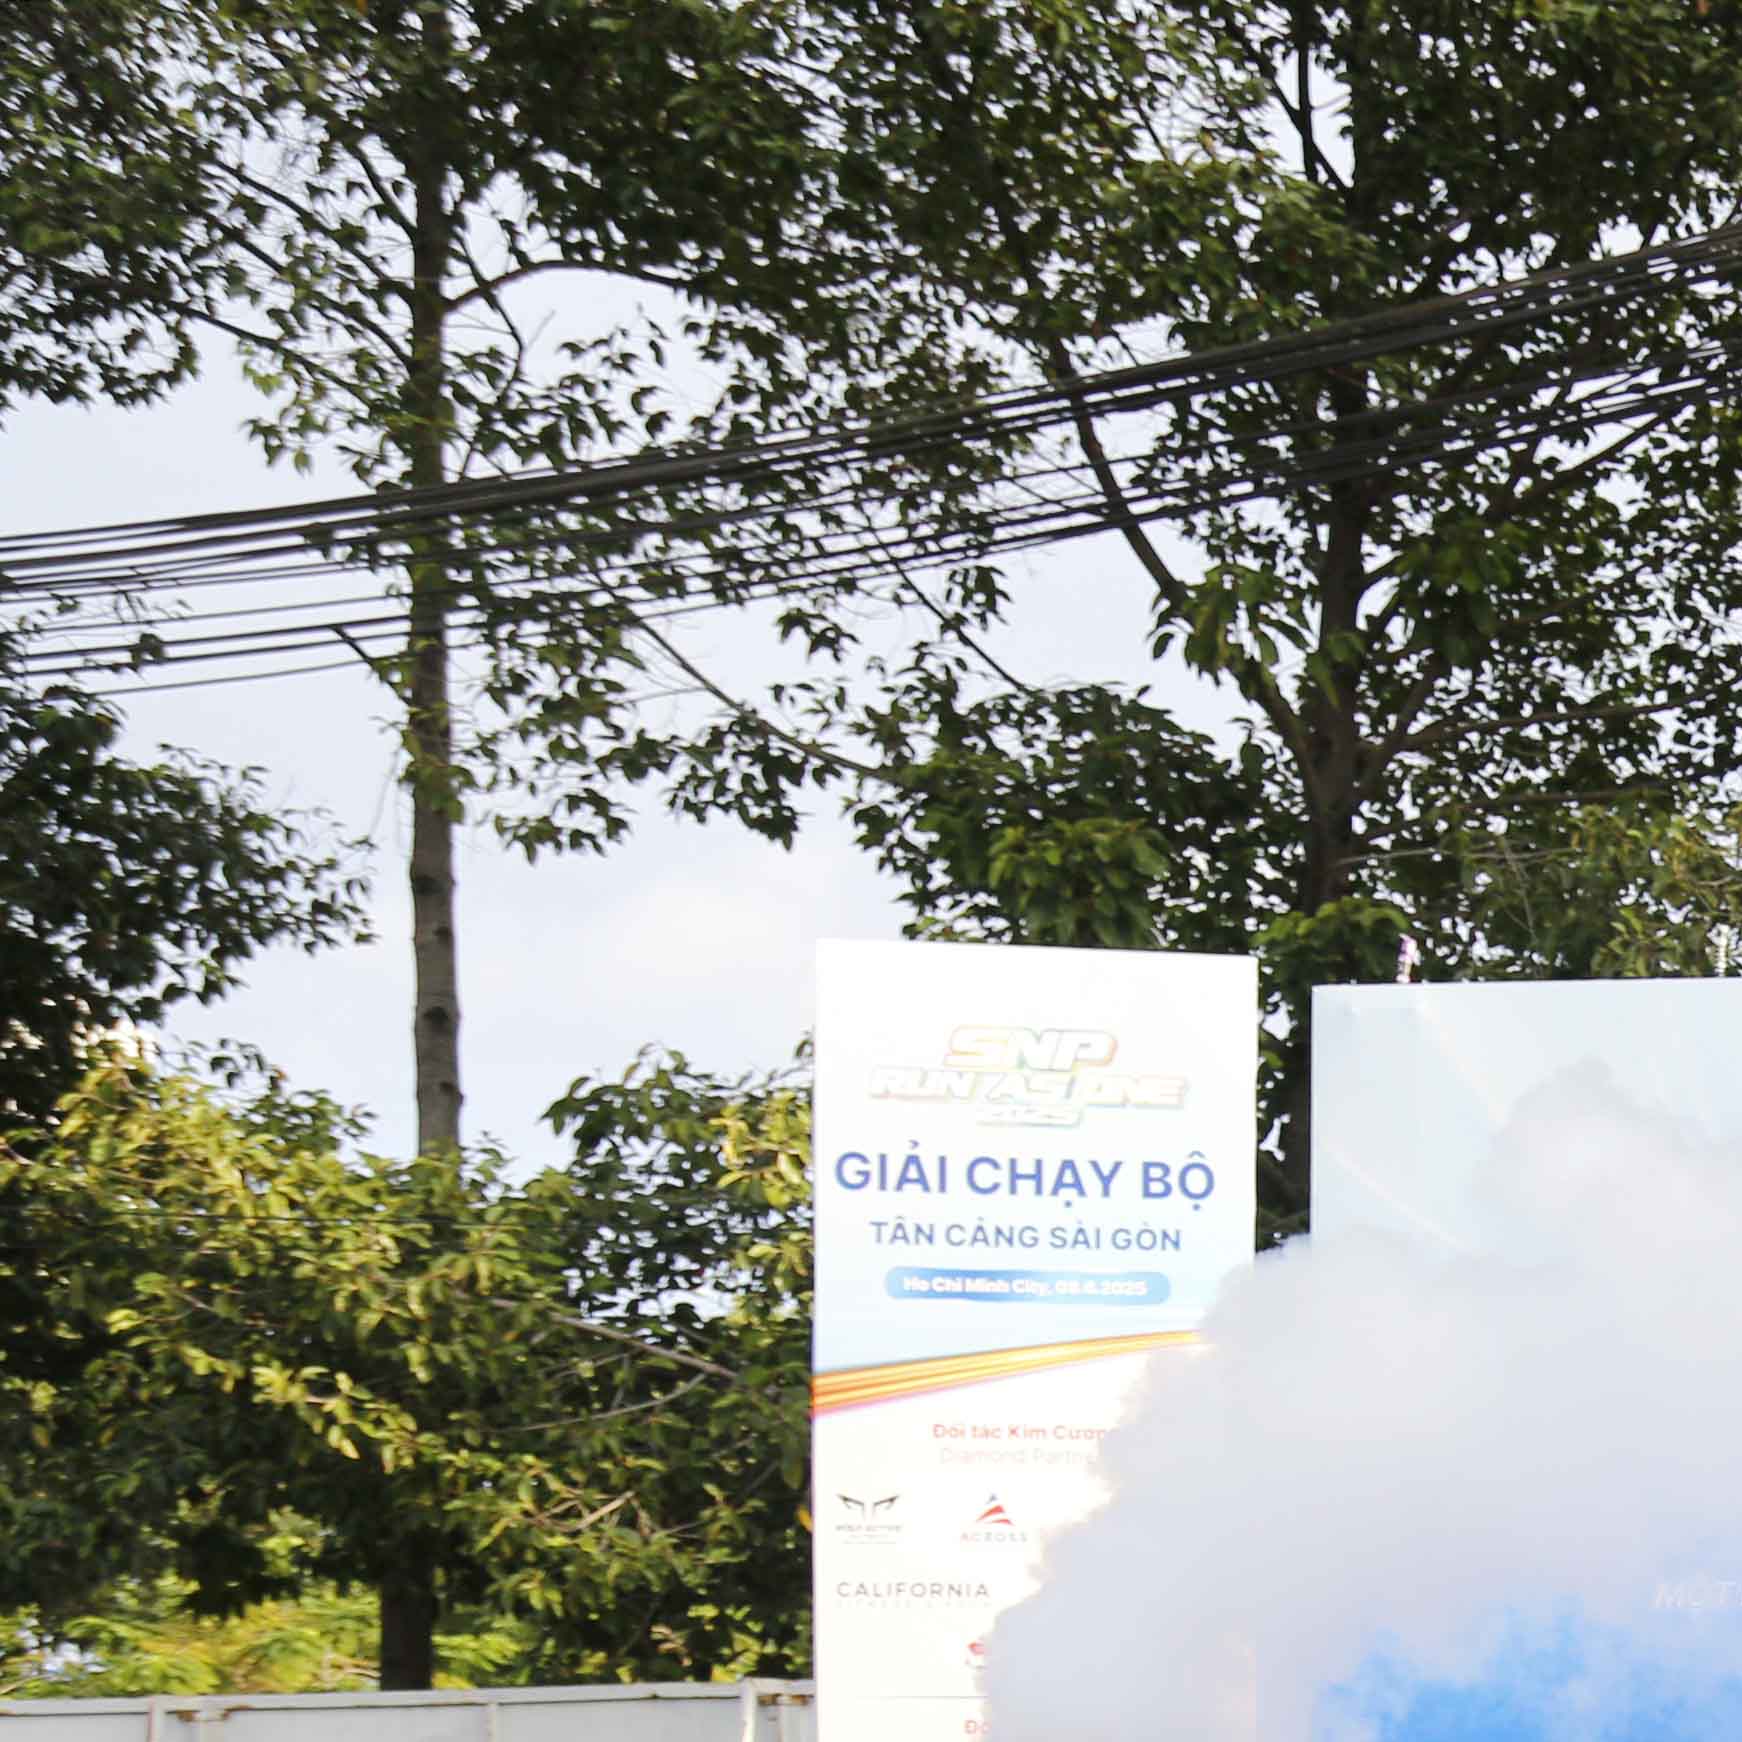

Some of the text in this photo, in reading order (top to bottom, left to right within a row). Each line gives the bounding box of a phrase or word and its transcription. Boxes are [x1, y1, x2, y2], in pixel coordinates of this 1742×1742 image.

[944, 1025, 1118, 1072] SNP
[834, 1139, 1216, 1212] GIẢI CHẠY BỘ
[870, 1217, 1182, 1252] TÂN CẢNG SÀI GÒN
[836, 1582, 991, 1599] CALIFORNIA
